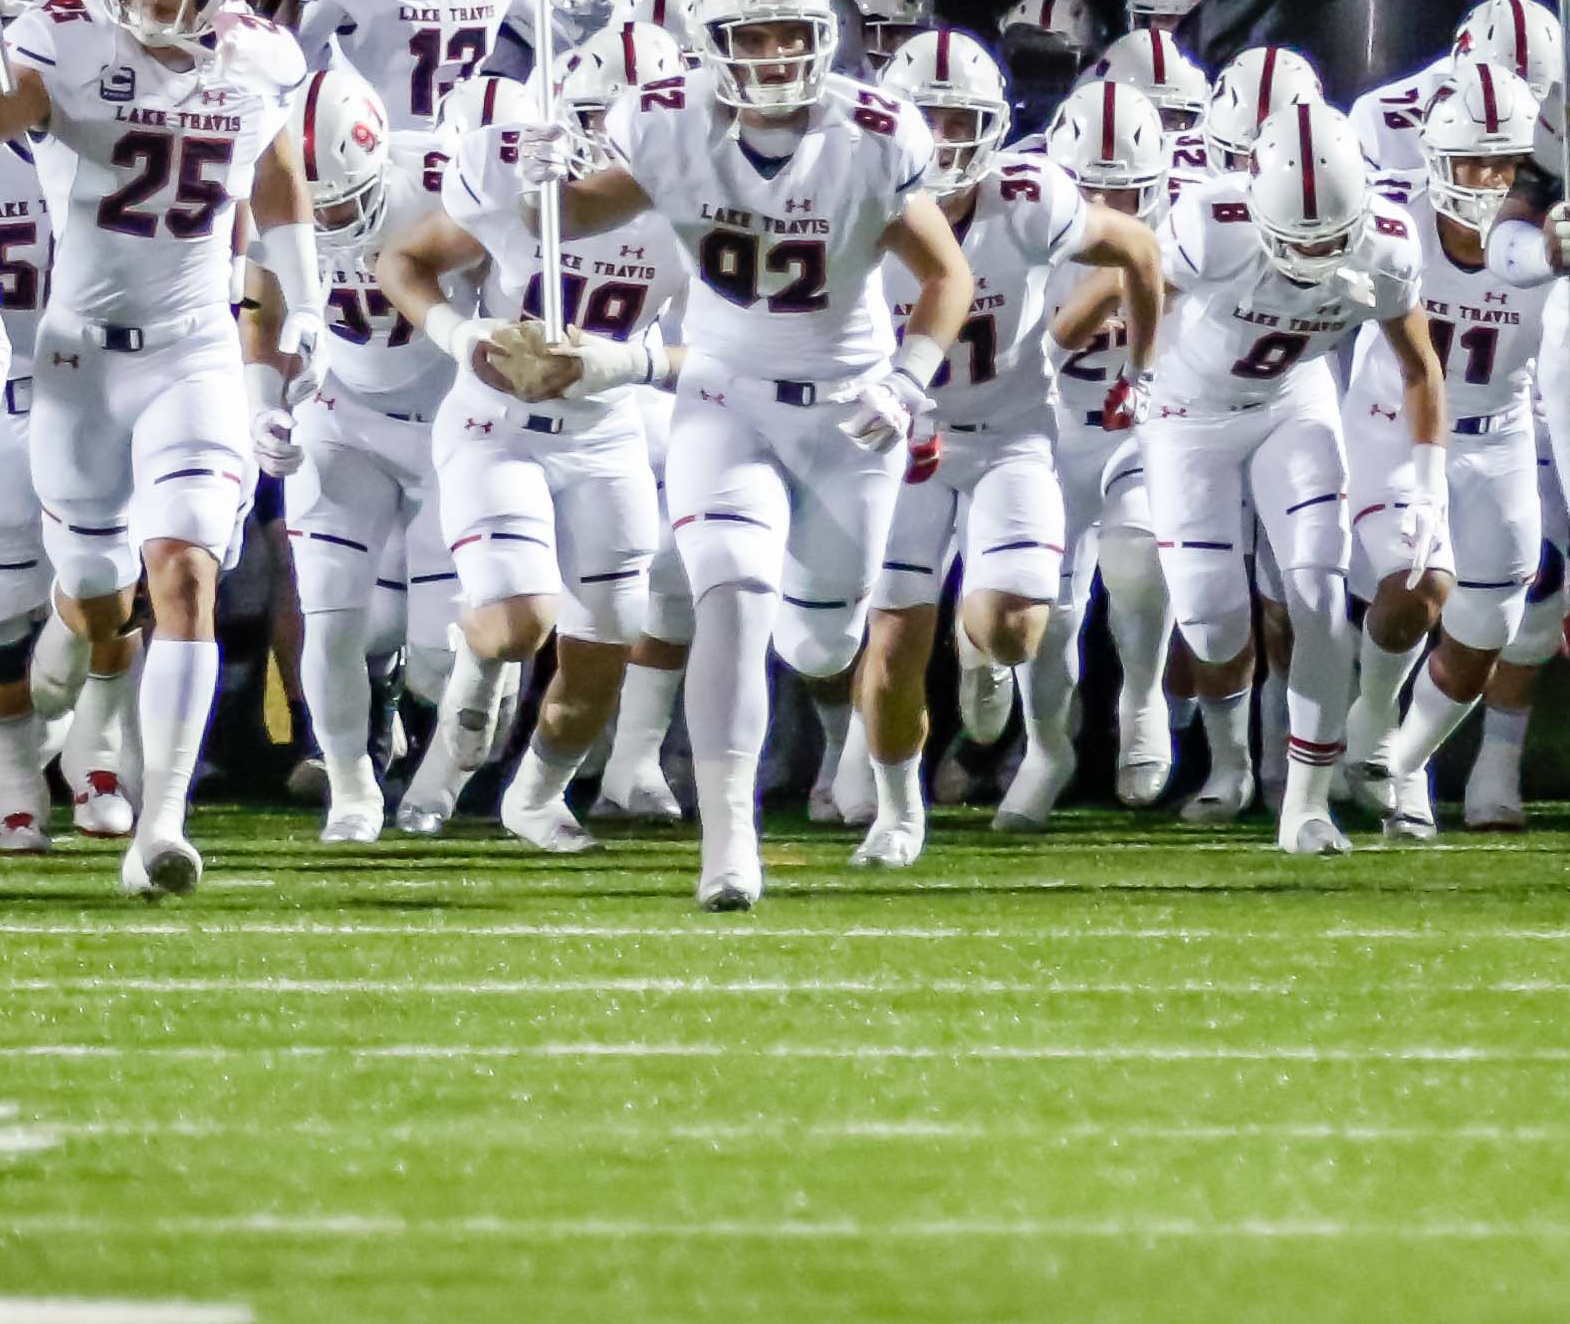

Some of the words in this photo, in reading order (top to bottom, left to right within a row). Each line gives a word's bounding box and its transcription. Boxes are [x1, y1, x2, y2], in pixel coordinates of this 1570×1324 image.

[398, 6, 441, 22] LAKE
[449, 4, 496, 22] TRAVIS
[115, 106, 167, 126] LAKE
[180, 113, 242, 132] TRAVIS
[97, 131, 235, 238] 25
[701, 203, 752, 228] LAKE
[762, 216, 830, 234] TRAVIS
[535, 245, 584, 270] LKE
[594, 261, 656, 280] TRAVIS
[1232, 305, 1281, 327] LAKE
[1458, 305, 1520, 325] TRAVIS
